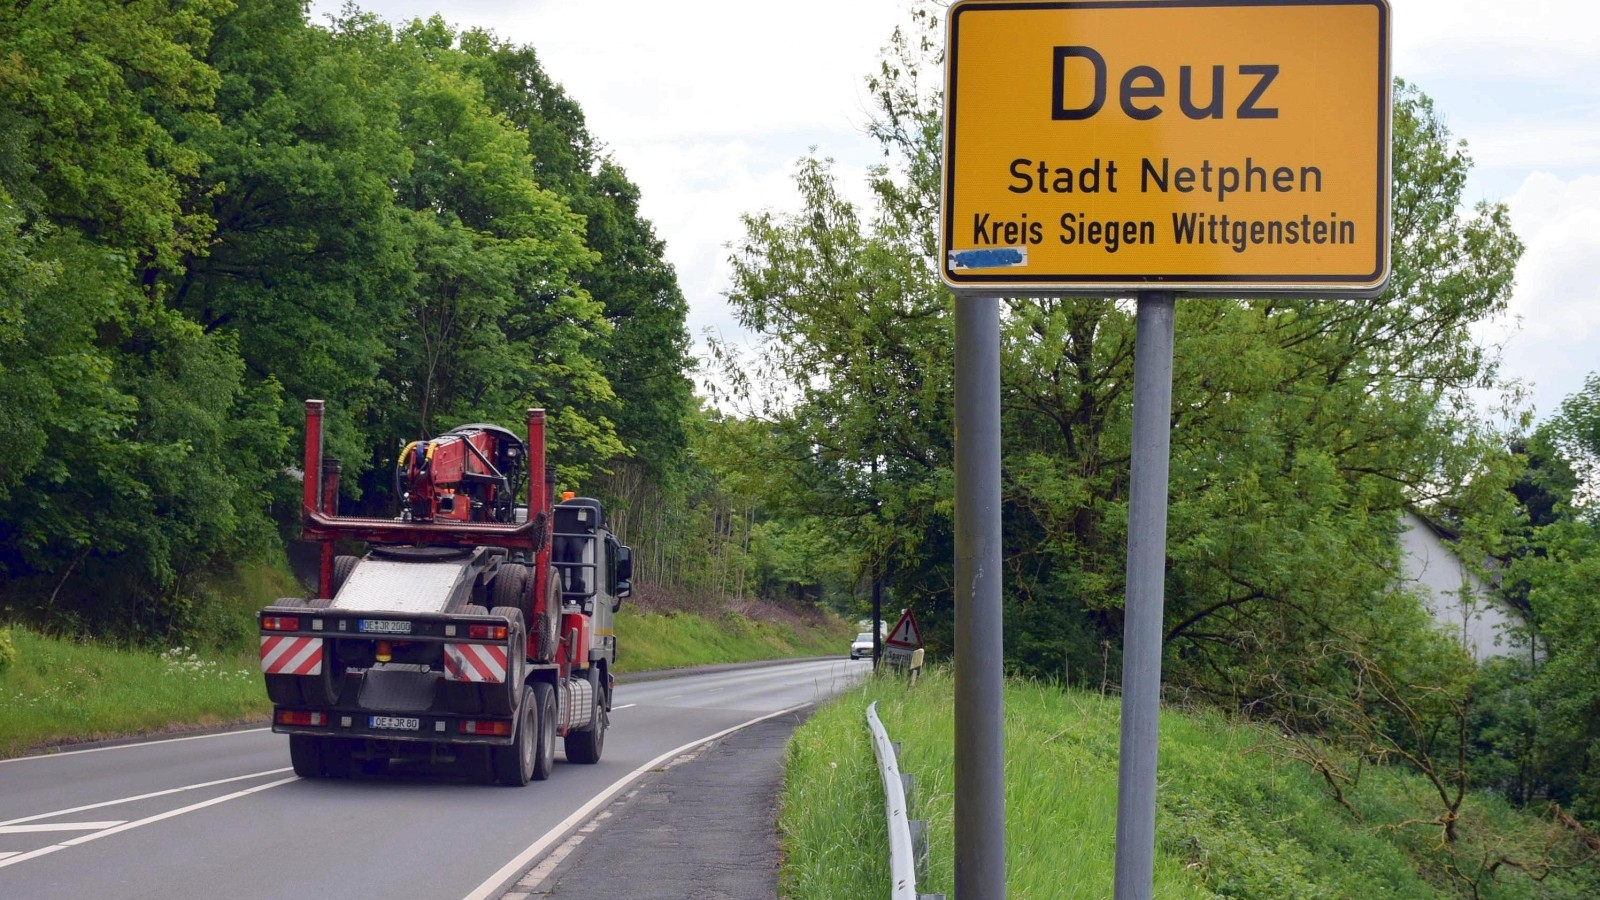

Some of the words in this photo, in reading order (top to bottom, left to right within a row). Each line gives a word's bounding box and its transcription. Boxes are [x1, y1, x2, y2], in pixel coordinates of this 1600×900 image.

[1052, 46, 1279, 120] Deuz
[1008, 158, 1117, 193] Stadt
[1141, 158, 1321, 202] Netphen
[974, 213, 1042, 244] Kreis
[1060, 213, 1154, 253] Siegen
[1172, 213, 1354, 252] Wittgenstein
